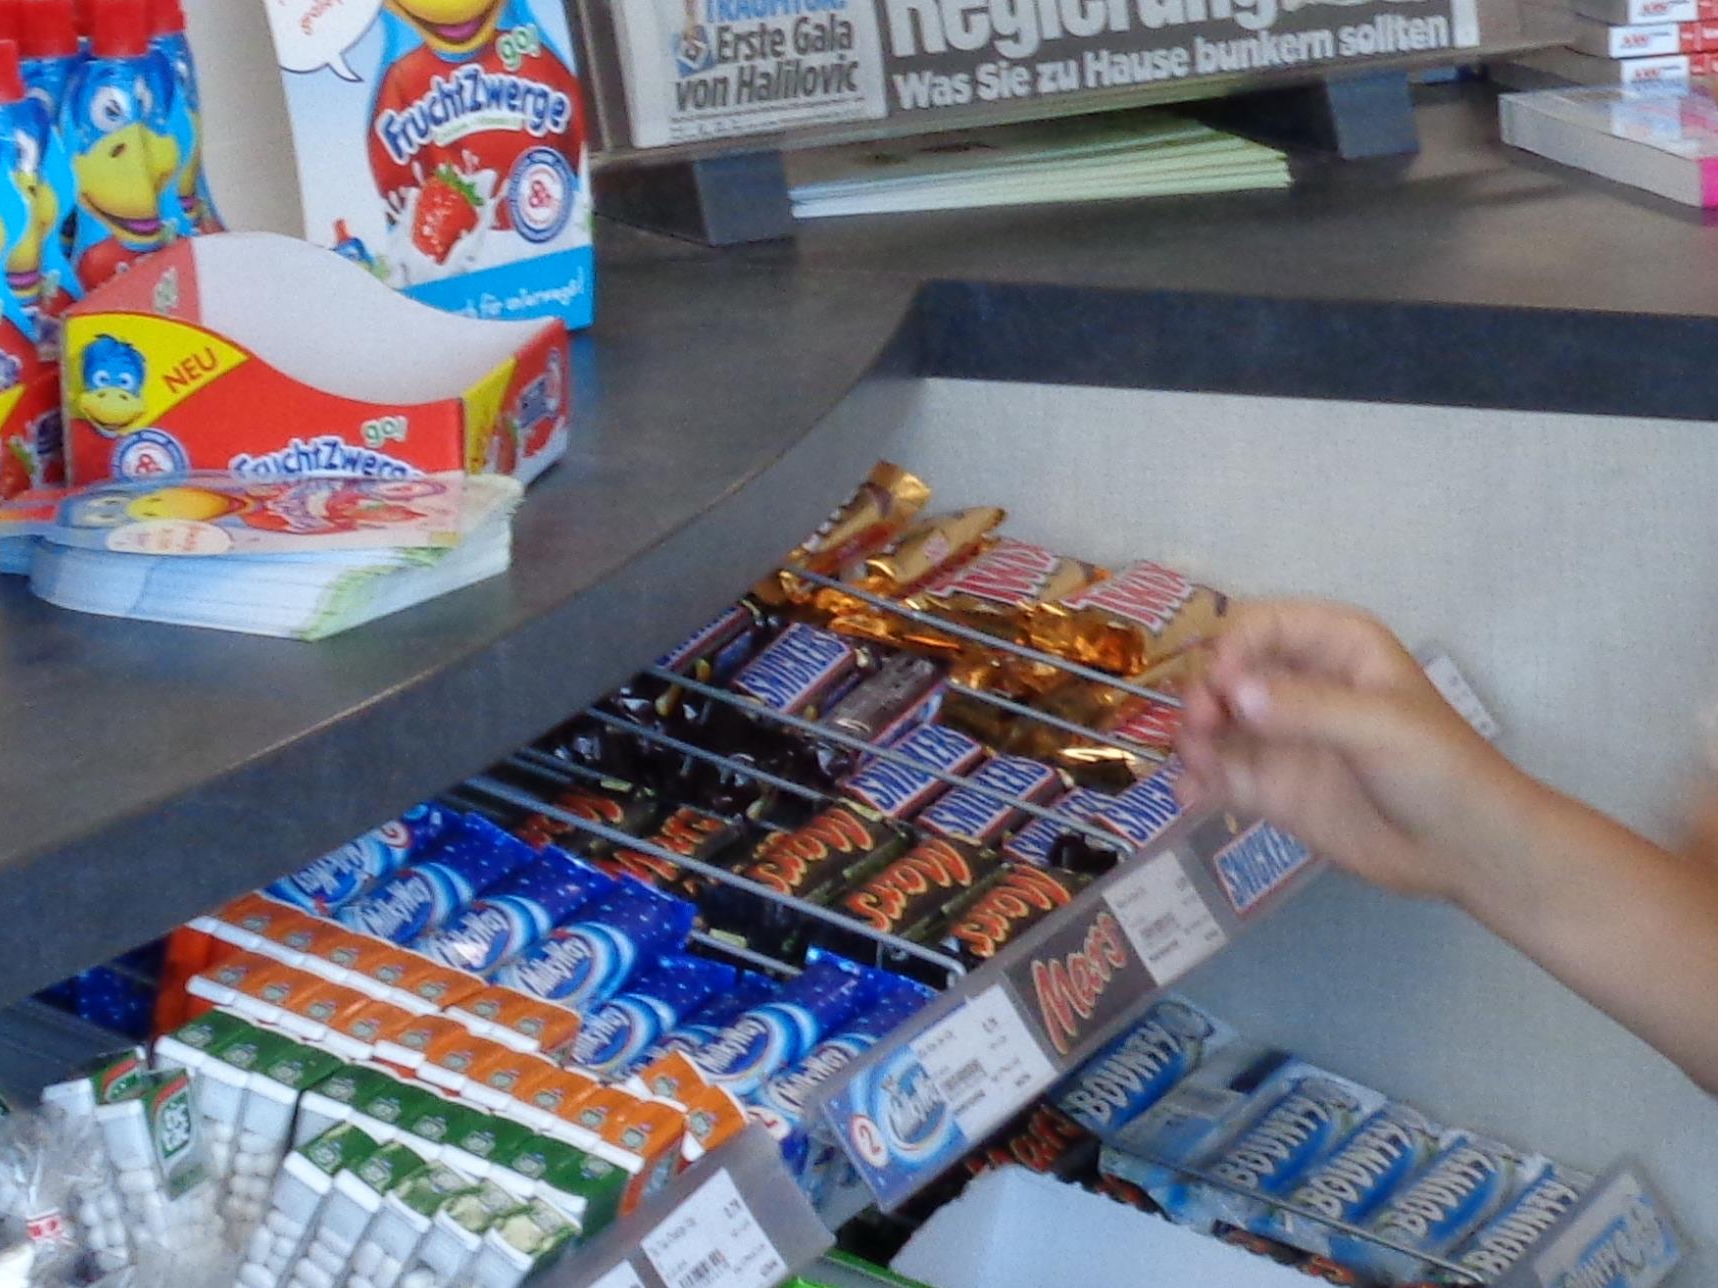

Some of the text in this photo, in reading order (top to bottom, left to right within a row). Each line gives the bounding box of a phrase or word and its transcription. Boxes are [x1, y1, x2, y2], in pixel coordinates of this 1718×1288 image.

[496, 24, 541, 71] go!
[716, 13, 853, 65] Erste Gala
[891, 13, 1451, 111] Was Sie zu Hause bunkern sollten
[376, 63, 571, 165] FruchtZwerge
[676, 75, 728, 112] von
[162, 347, 221, 394] NEU
[361, 416, 408, 447] go!
[926, 536, 1060, 608] TWIX
[1060, 560, 1194, 633] TWIX
[741, 626, 848, 710] SNICKERS
[847, 838, 973, 933] Mars
[950, 862, 1072, 958] Mars
[1030, 911, 1129, 1056] Mars
[1072, 1021, 1182, 1126] BOUNTY
[1217, 1094, 1329, 1190] BOUNTY
[1312, 1119, 1413, 1218] BOUNTY
[1392, 1144, 1497, 1236] BOUNTY
